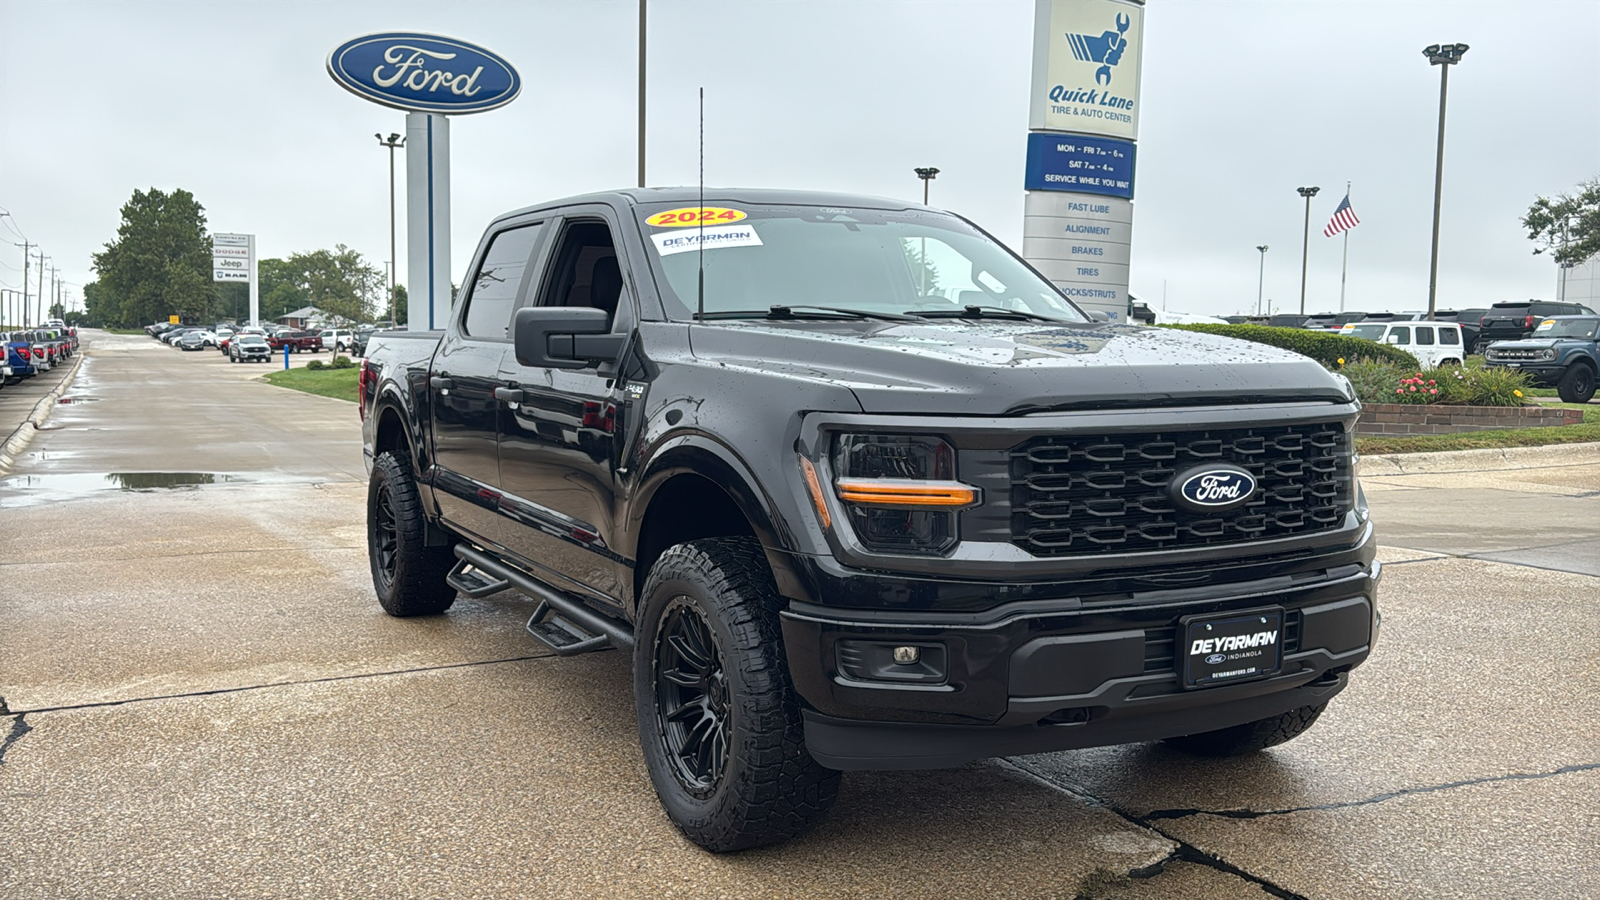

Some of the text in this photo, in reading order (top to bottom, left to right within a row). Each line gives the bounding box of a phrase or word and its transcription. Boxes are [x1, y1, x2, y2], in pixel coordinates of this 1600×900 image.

[372, 44, 485, 97] Ford
[1049, 85, 1134, 110] Quick Lane
[1051, 105, 1132, 124] TIRE & AUTO CENTER
[1057, 144, 1075, 153] MON
[1083, 146, 1095, 154] FRI
[1068, 160, 1083, 169] SAT
[1045, 174, 1129, 189] SERVICE WHILE YOU WAIT
[1067, 202, 1110, 214] FAST LUBE
[658, 210, 737, 226] 2024
[1065, 224, 1110, 235] ALIGNMENT
[663, 232, 750, 247] DEYARMAN
[1071, 246, 1104, 256] BRAKES
[220, 259, 242, 268] Jeep
[1077, 267, 1099, 277] TIRES
[1061, 287, 1116, 299] OCKS/STRUTS
[1196, 475, 1241, 500] Ford
[1190, 630, 1278, 655] DEYARMAN
[1227, 650, 1262, 660] INDIANOLA
